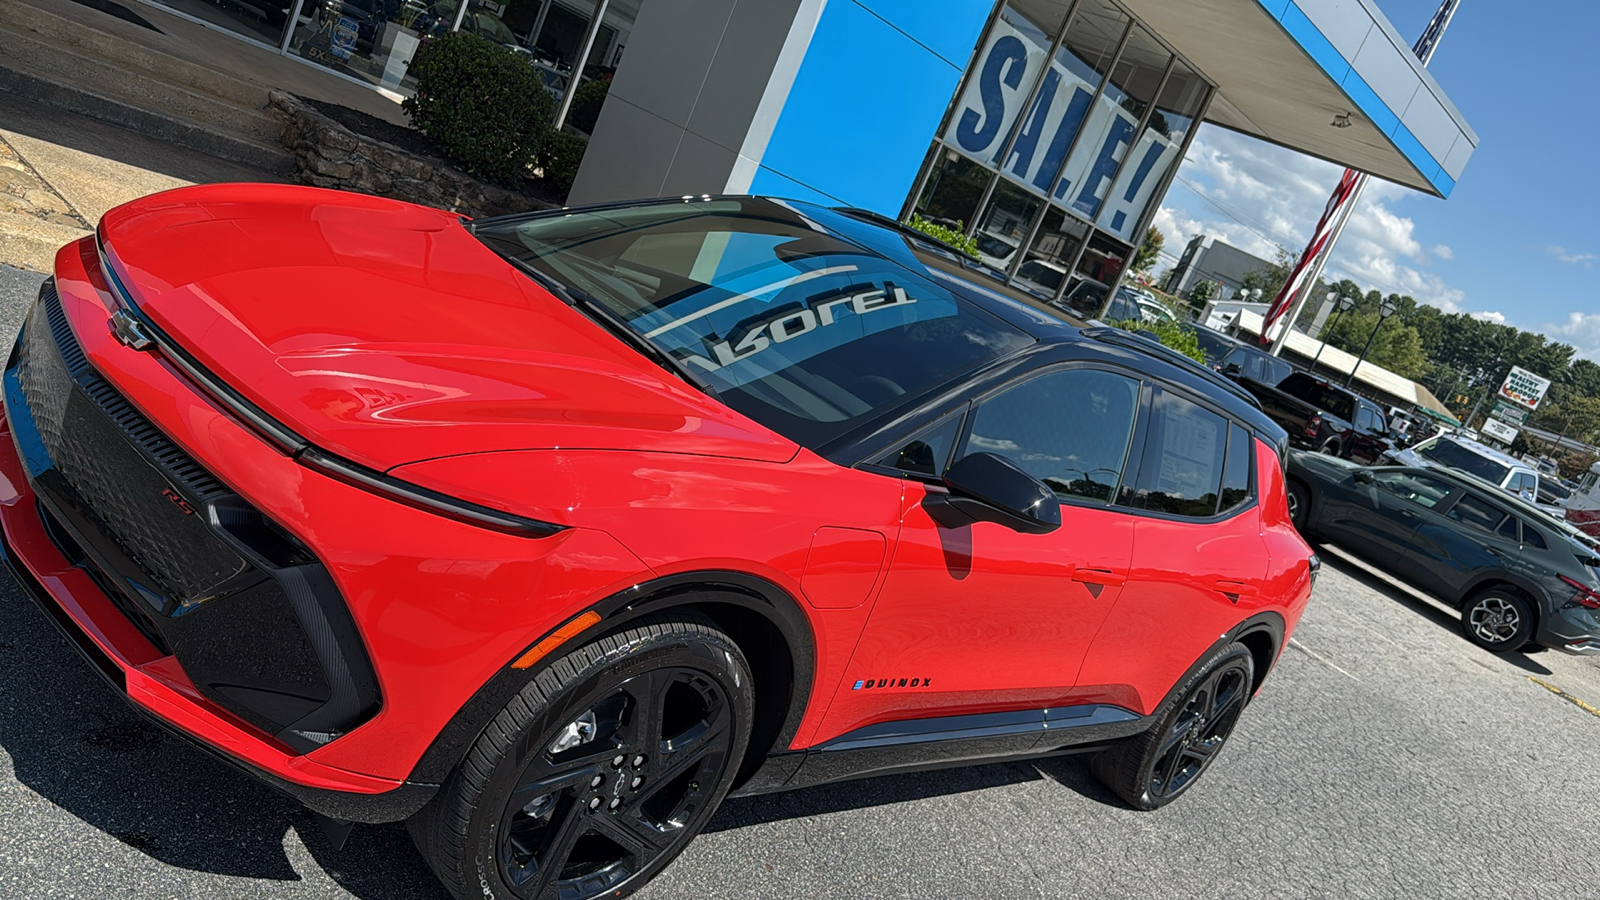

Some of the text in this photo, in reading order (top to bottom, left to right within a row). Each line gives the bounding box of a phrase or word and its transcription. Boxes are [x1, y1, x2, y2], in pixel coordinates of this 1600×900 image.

[956, 35, 1167, 232] SALE!
[1509, 372, 1540, 388] HEALTHY
[1509, 378, 1540, 395] HARVEST
[162, 487, 197, 515] RS
[852, 677, 932, 691] EQUINOX
